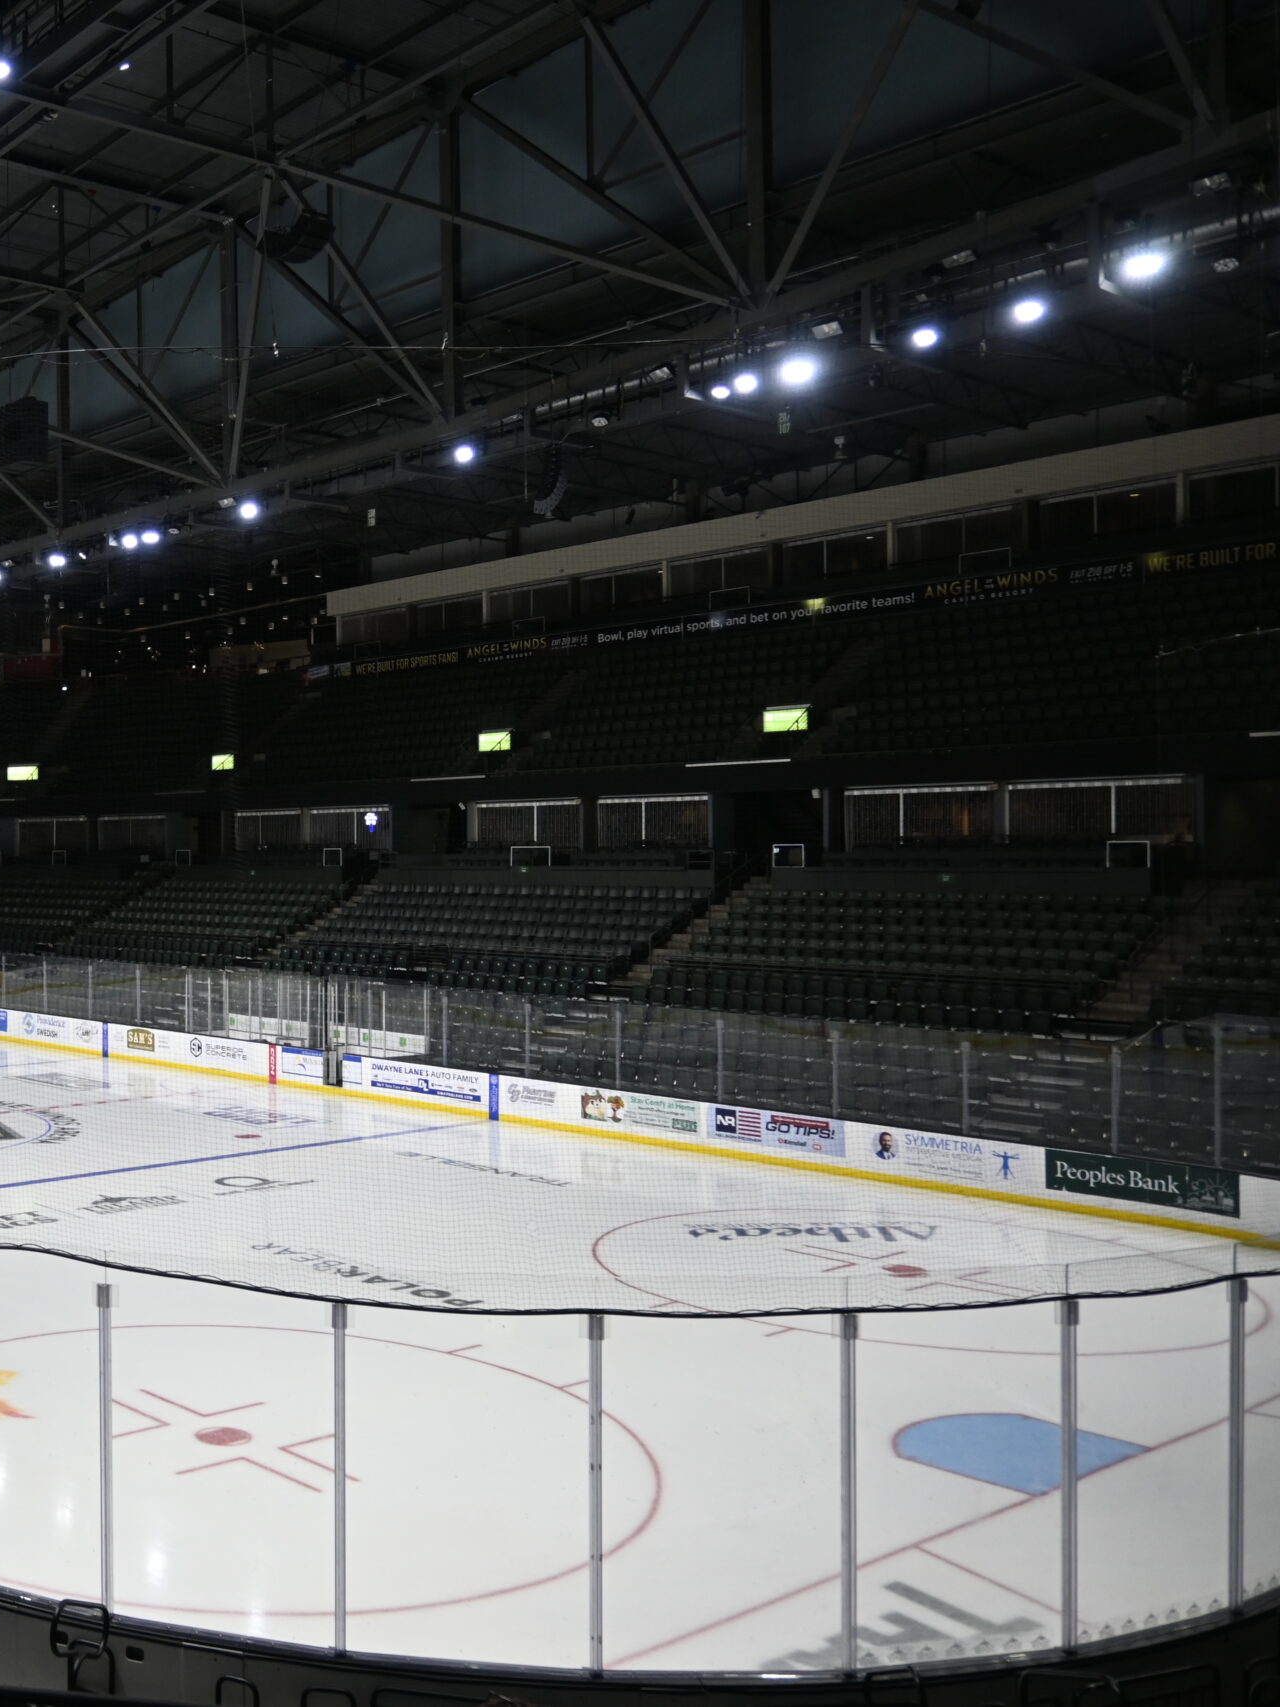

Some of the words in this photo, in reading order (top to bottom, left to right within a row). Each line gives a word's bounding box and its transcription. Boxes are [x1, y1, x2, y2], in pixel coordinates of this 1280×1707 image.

[1200, 546, 1241, 567] BUILT
[1245, 542, 1276, 560] FOR
[924, 579, 982, 599] ANGEL
[996, 568, 1059, 589] WINDS
[990, 588, 1034, 599] RESORT
[597, 630, 625, 644] Bowl,
[627, 628, 649, 640] play
[650, 623, 684, 636] virtual
[686, 618, 724, 632] sports,
[726, 614, 747, 626] and
[749, 612, 769, 624] bet
[772, 610, 787, 620] on
[820, 600, 868, 615] favorite
[872, 592, 915, 608] teams!
[467, 643, 500, 659] ANGEL
[509, 637, 548, 652] WINDS
[377, 660, 395, 672] BUILT
[397, 657, 410, 670] FOR
[410, 654, 437, 668] SPORTS
[438, 651, 459, 665] FANS!
[127, 1031, 153, 1045] SAM'S
[205, 1043, 244, 1053] SUPERIOR
[205, 1050, 248, 1061] CONCRETE
[372, 1063, 403, 1074] DWAYNE
[430, 1071, 451, 1080] AUTO
[452, 1075, 479, 1084] FAMILY
[765, 1121, 790, 1134] GO
[793, 1124, 835, 1140] TIPS!
[904, 1133, 983, 1155] SYMMETRIA
[1055, 1160, 1126, 1187] Peoples
[1128, 1169, 1181, 1194] Bank
